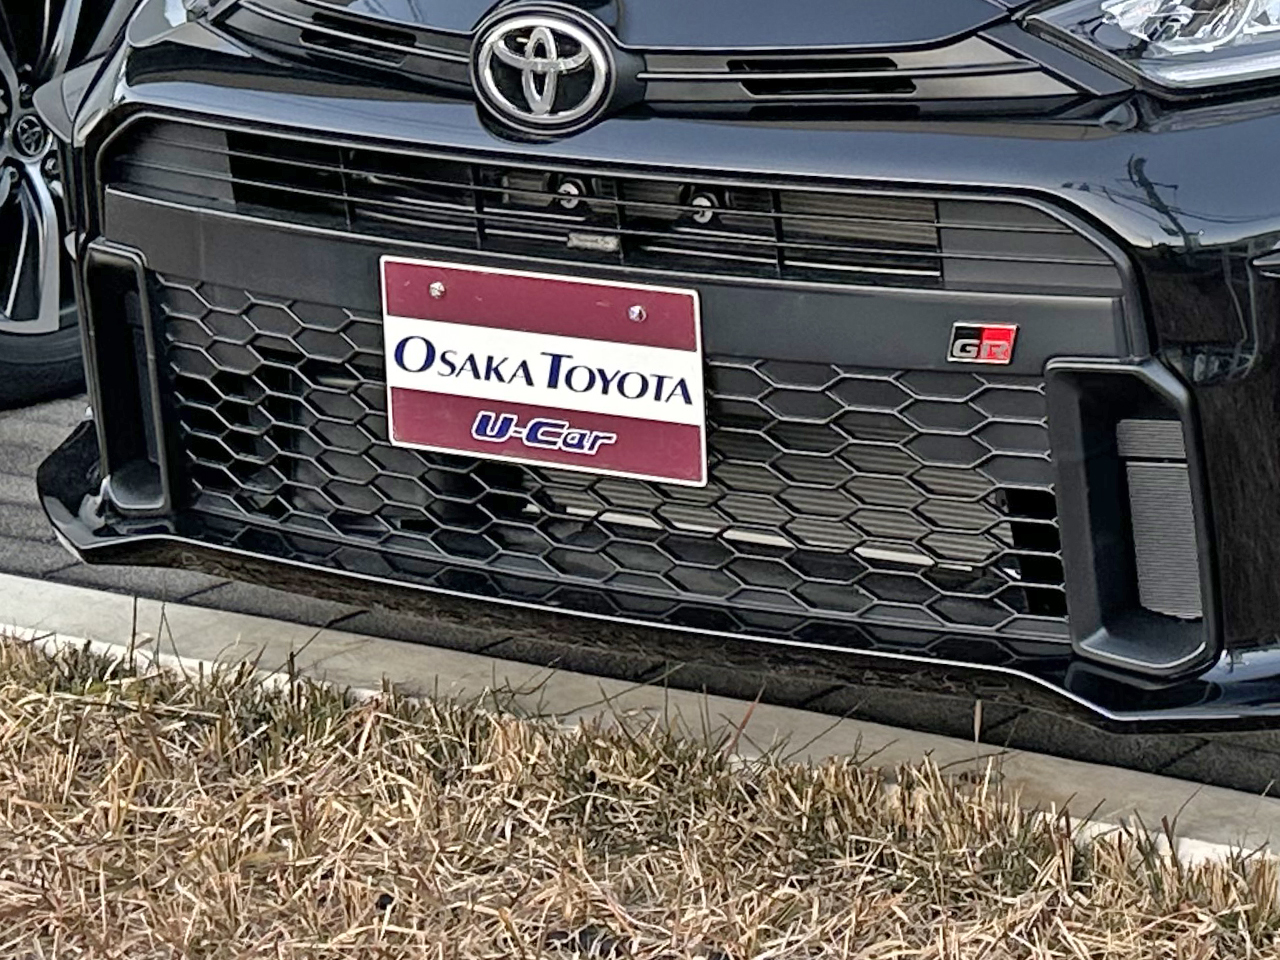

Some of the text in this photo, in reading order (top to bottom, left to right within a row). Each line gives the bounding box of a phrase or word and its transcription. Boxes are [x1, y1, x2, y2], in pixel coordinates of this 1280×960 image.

[394, 335, 693, 405] OSAKA TOYOTA
[471, 410, 617, 455] U-Car
